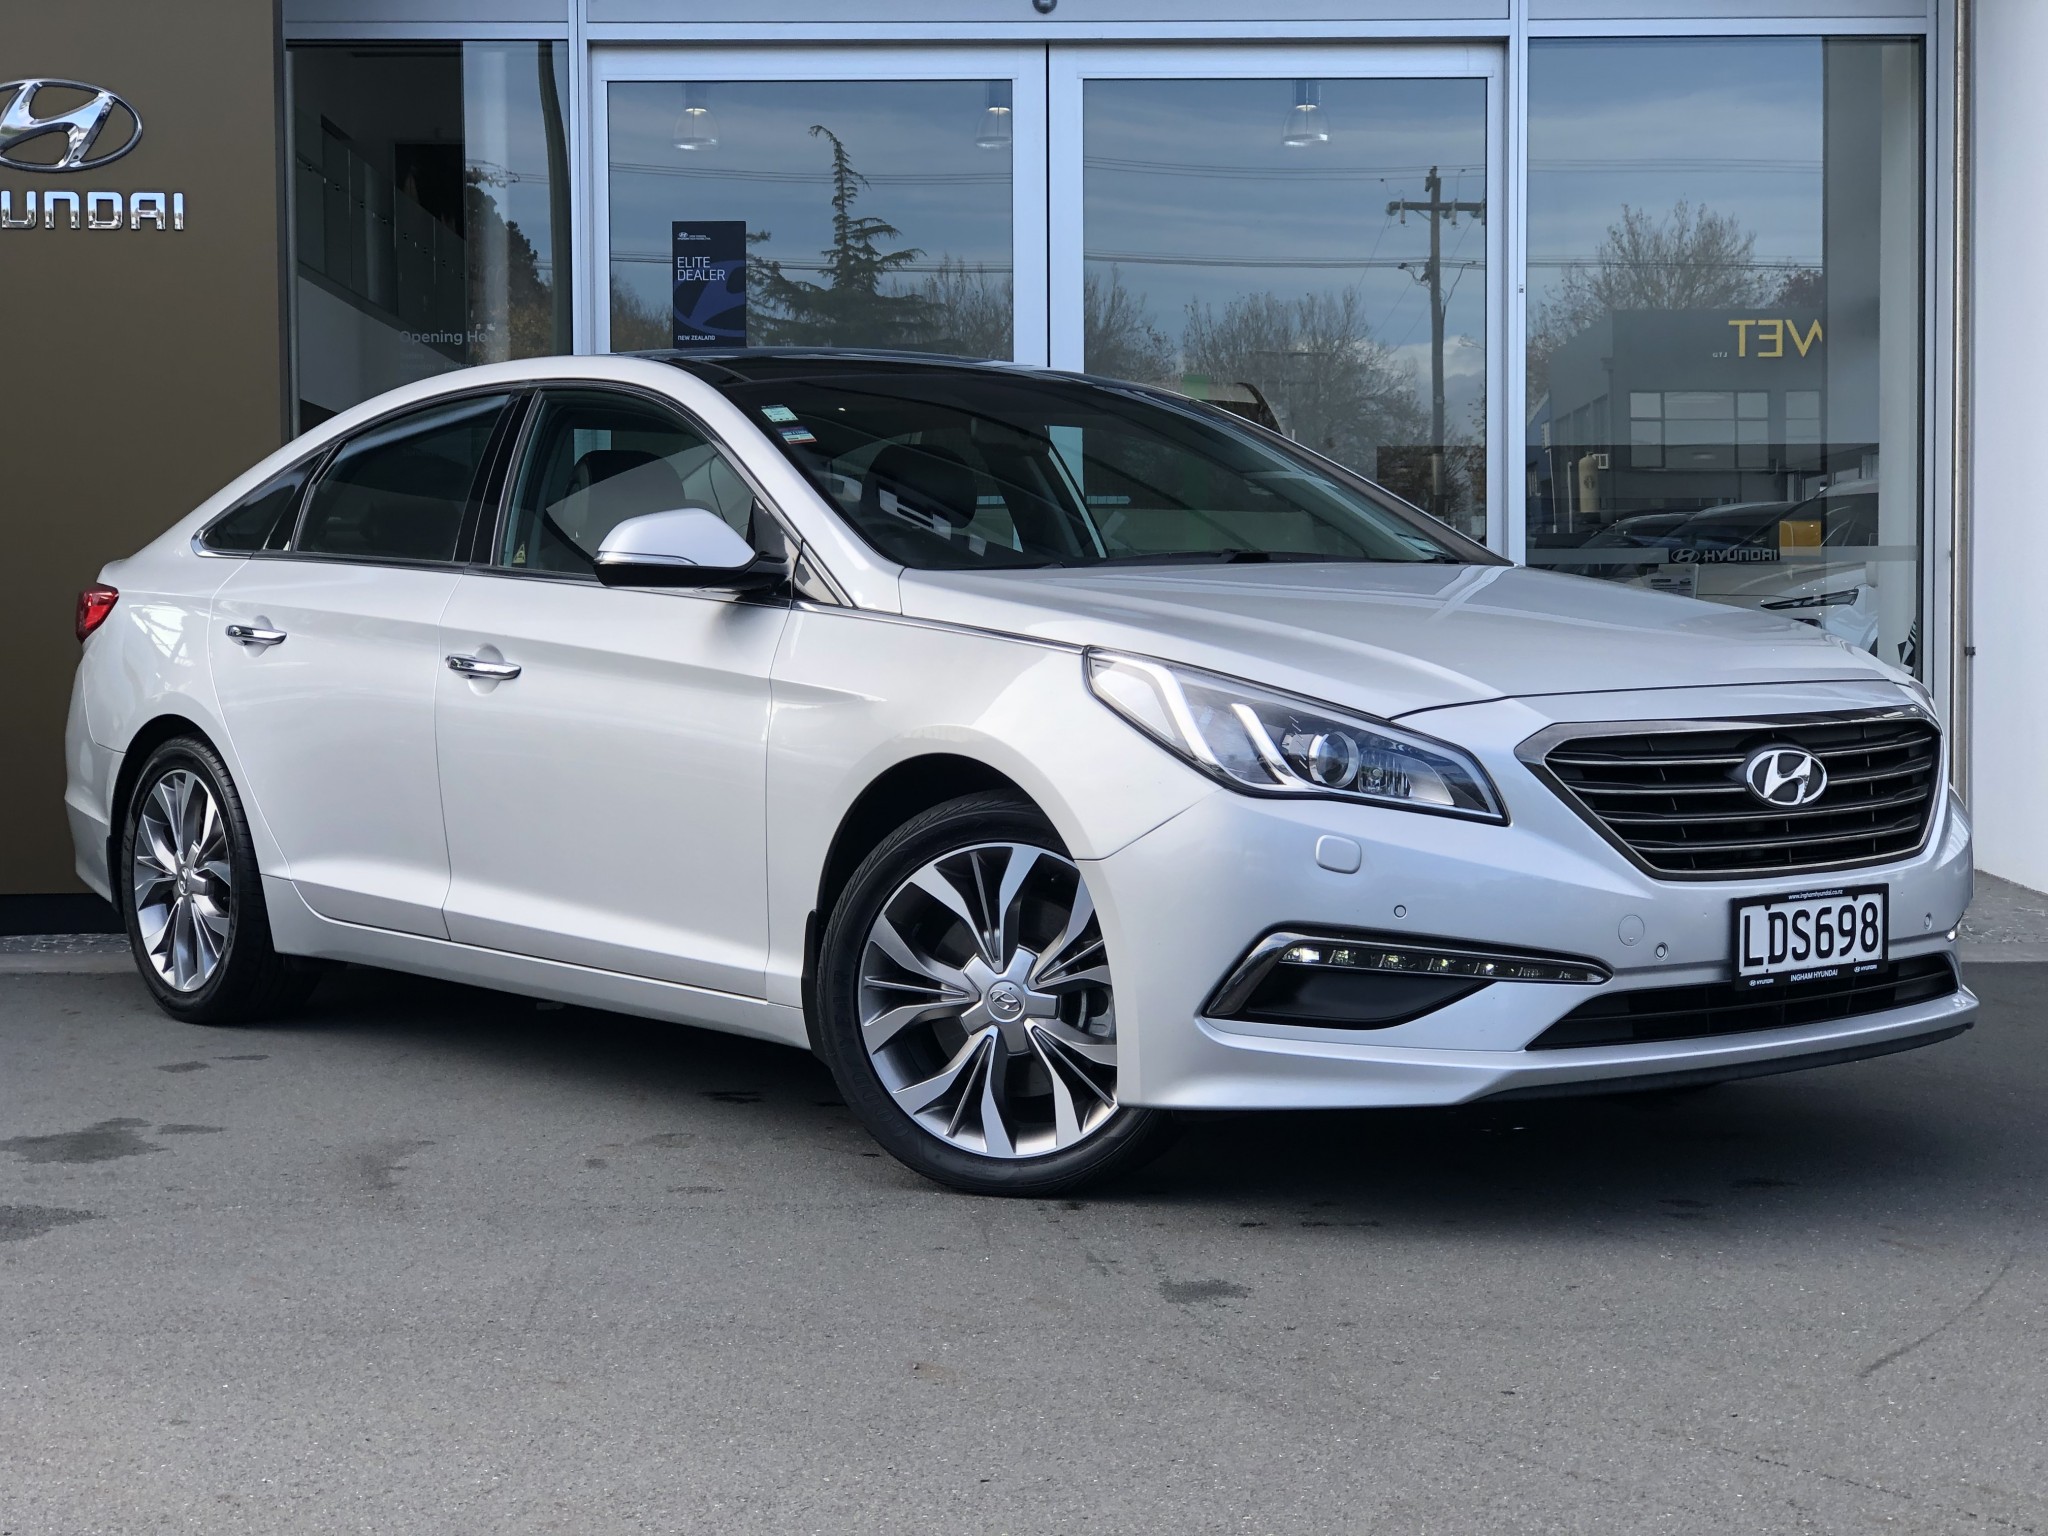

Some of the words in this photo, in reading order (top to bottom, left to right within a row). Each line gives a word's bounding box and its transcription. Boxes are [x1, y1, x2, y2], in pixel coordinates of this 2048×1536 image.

[677, 256, 711, 268] ELITE
[677, 269, 726, 281] DEALER
[399, 330, 463, 345] Opening
[1703, 549, 1778, 562] HYUNDAI
[1743, 902, 1879, 967] LDS698
[1790, 971, 1814, 982] INGHAM
[1813, 969, 1838, 979] HYUNDAI
